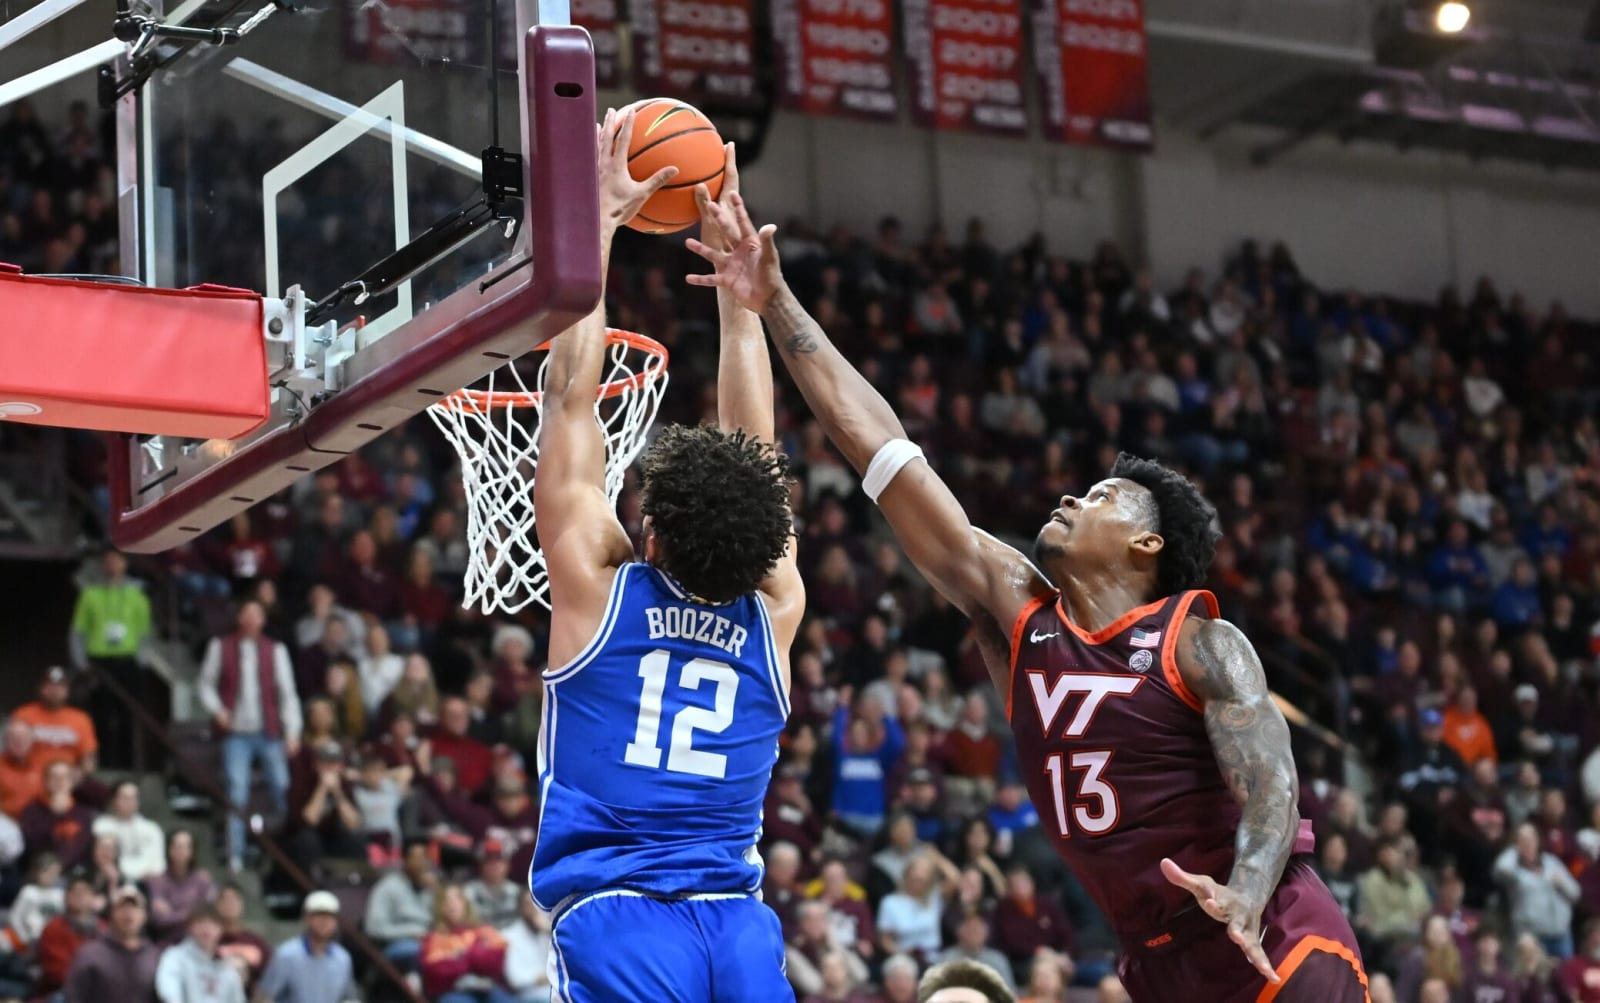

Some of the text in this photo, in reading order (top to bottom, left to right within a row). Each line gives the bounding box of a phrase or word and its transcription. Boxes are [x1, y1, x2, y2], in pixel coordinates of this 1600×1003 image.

[936, 5, 1019, 36] 2007
[942, 39, 1015, 69] 2017
[645, 606, 748, 658] BOOZER
[624, 648, 740, 779] 12
[1025, 669, 1147, 738] VT
[1044, 749, 1120, 838] 13
